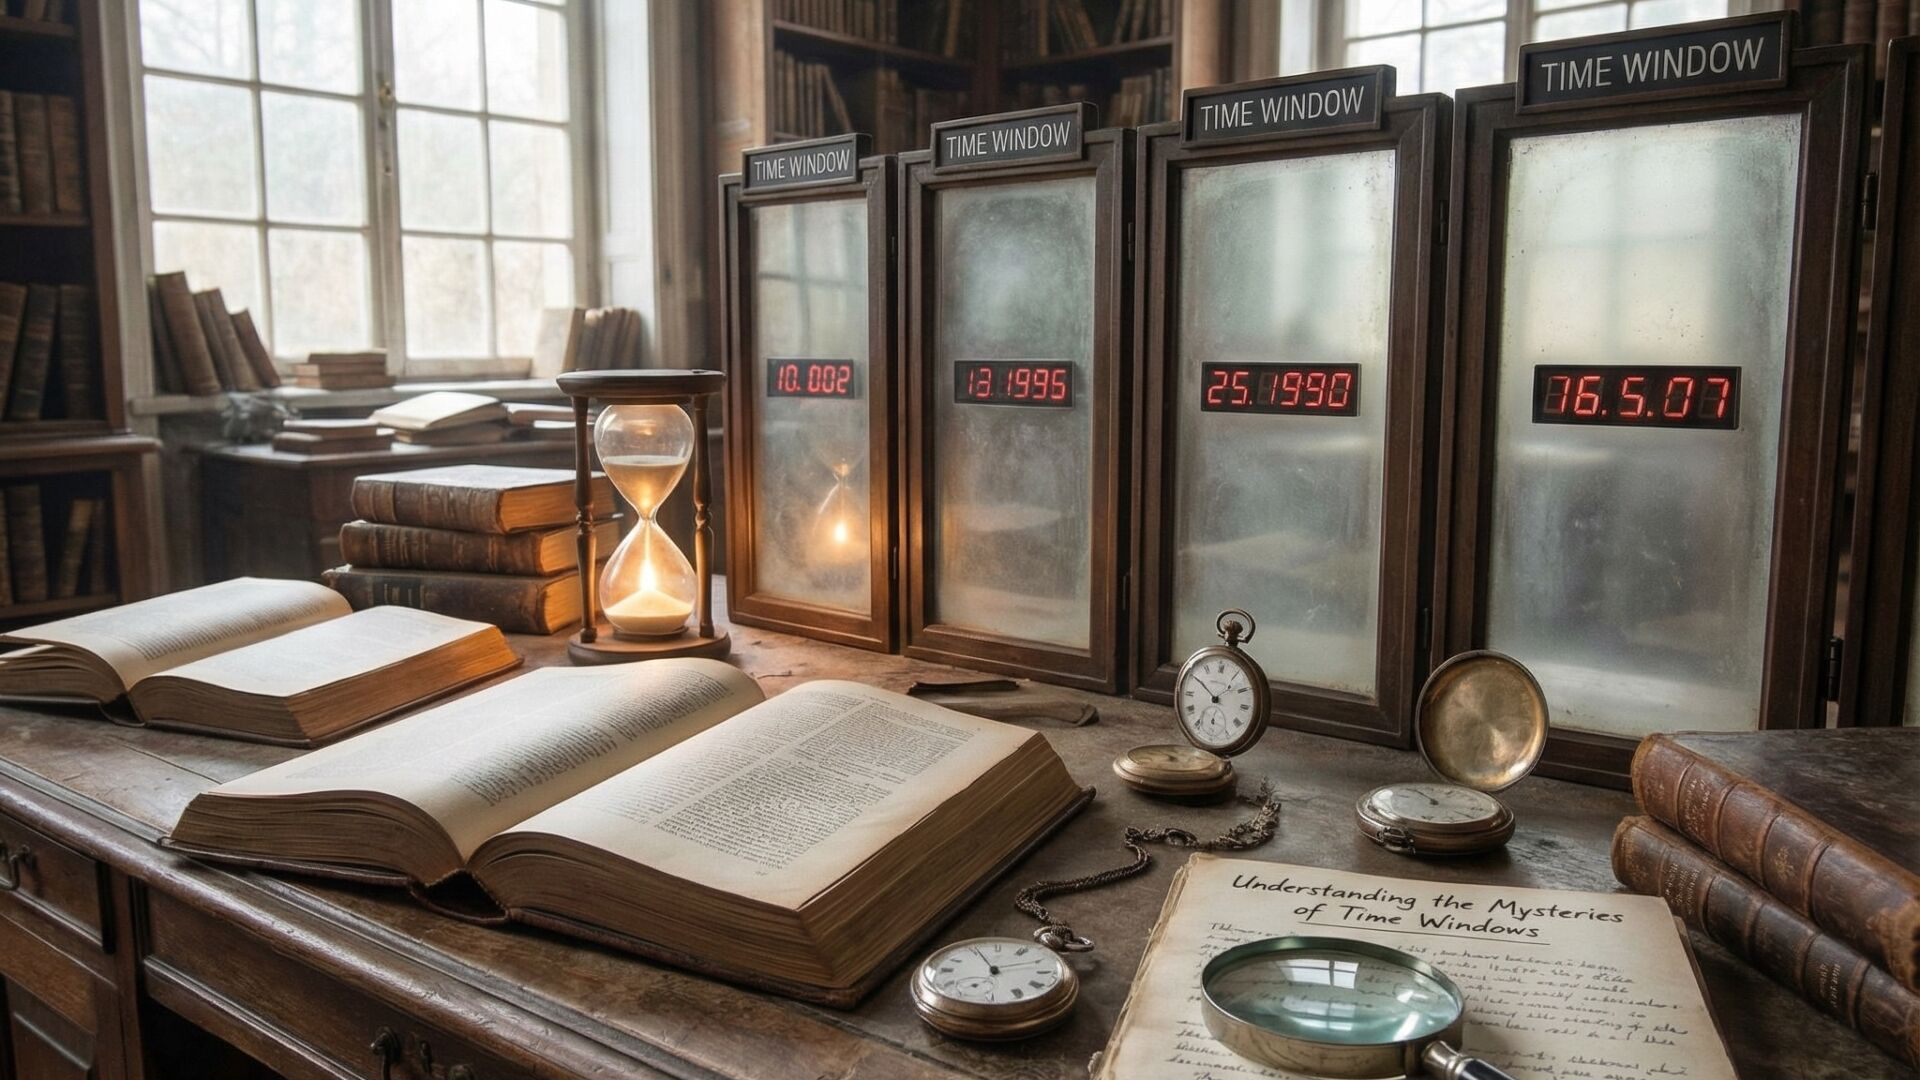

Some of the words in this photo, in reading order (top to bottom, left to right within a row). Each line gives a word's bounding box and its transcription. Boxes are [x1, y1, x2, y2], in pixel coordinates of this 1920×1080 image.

[1541, 56, 1613, 92] TIME
[1622, 37, 1764, 84] WINDOW
[1200, 100, 1254, 131] TIME
[1260, 85, 1365, 124] WINDOW
[946, 132, 987, 159] TIME
[992, 120, 1071, 153] WINDOW
[754, 157, 786, 181] TIME
[789, 148, 851, 178] WINDOW
[1232, 874, 1417, 911] Understanding
[1431, 894, 1474, 911] the
[1488, 898, 1624, 923] Mysteries
[1293, 903, 1327, 921] of
[1339, 904, 1402, 925] Time
[1420, 912, 1540, 939] Windows
